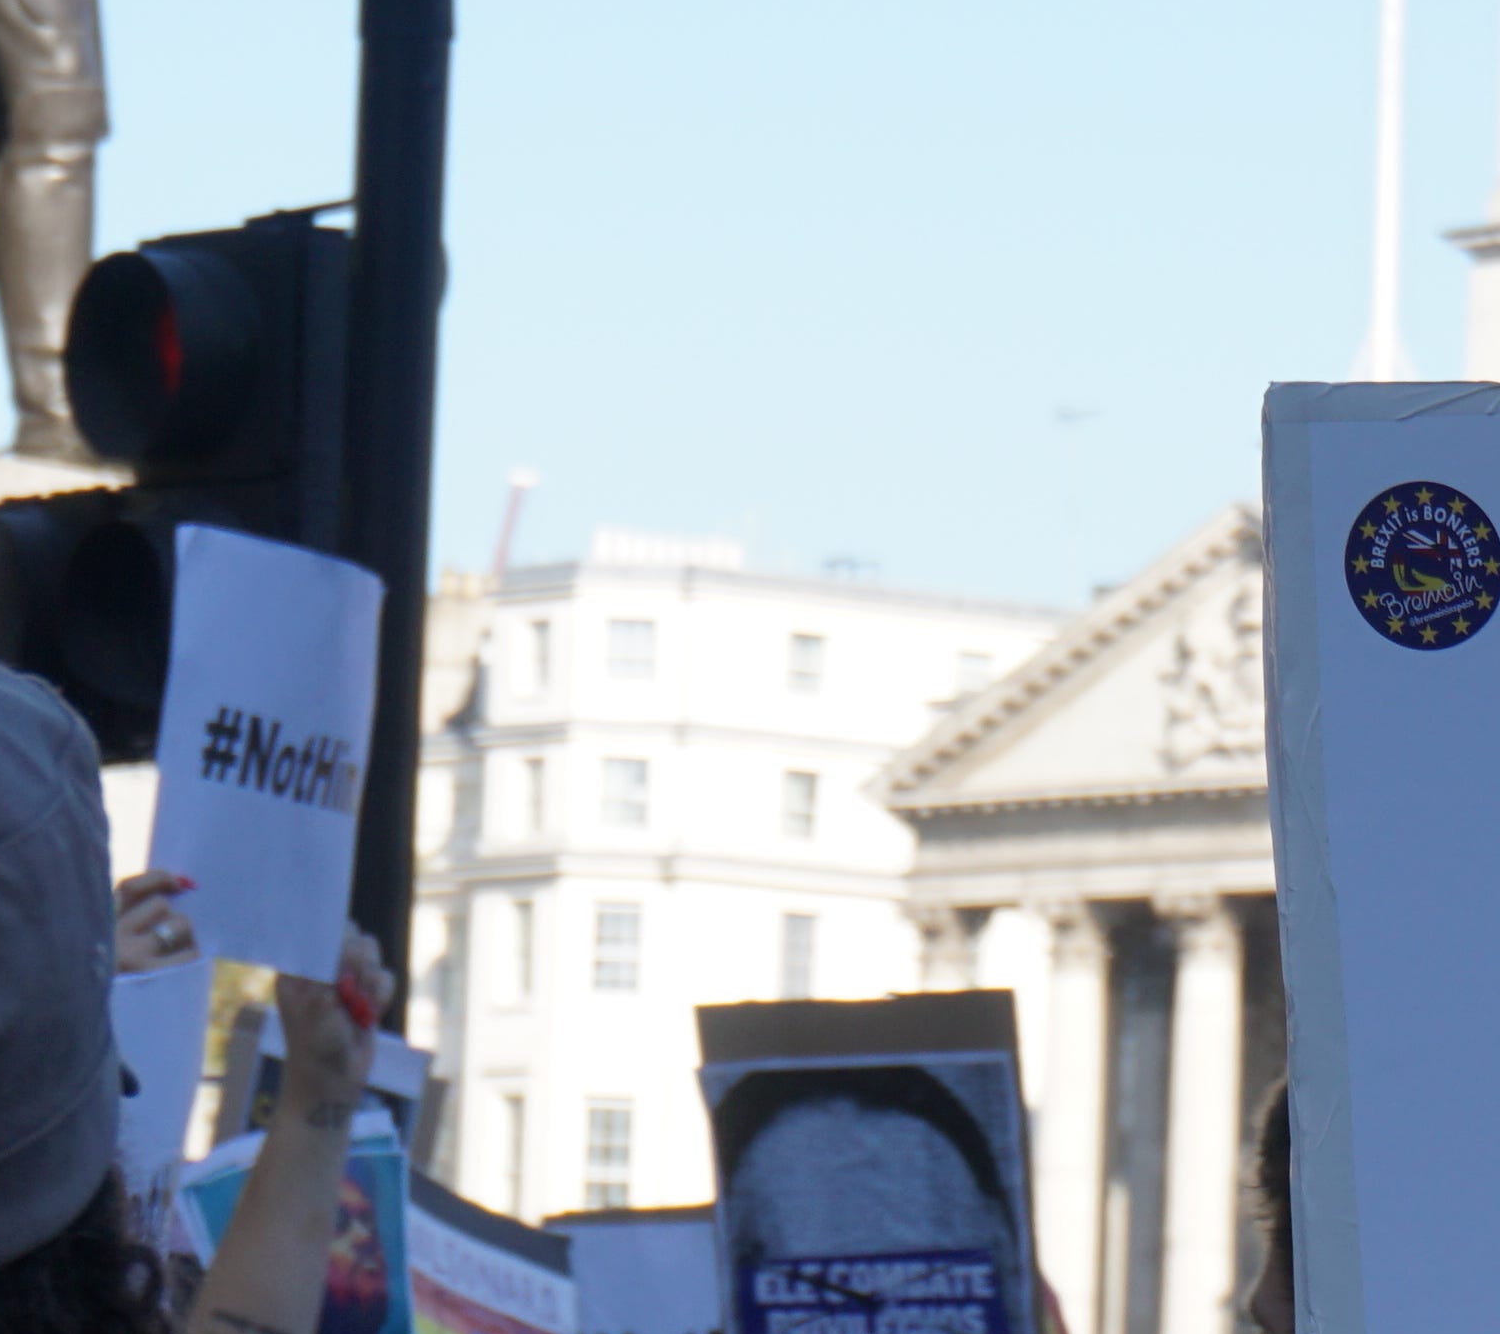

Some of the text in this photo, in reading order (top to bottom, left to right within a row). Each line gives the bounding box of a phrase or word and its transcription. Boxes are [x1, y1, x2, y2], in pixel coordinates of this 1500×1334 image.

[1370, 505, 1483, 569] BREXIT is BONKERS
[1380, 571, 1483, 619] Bremain
